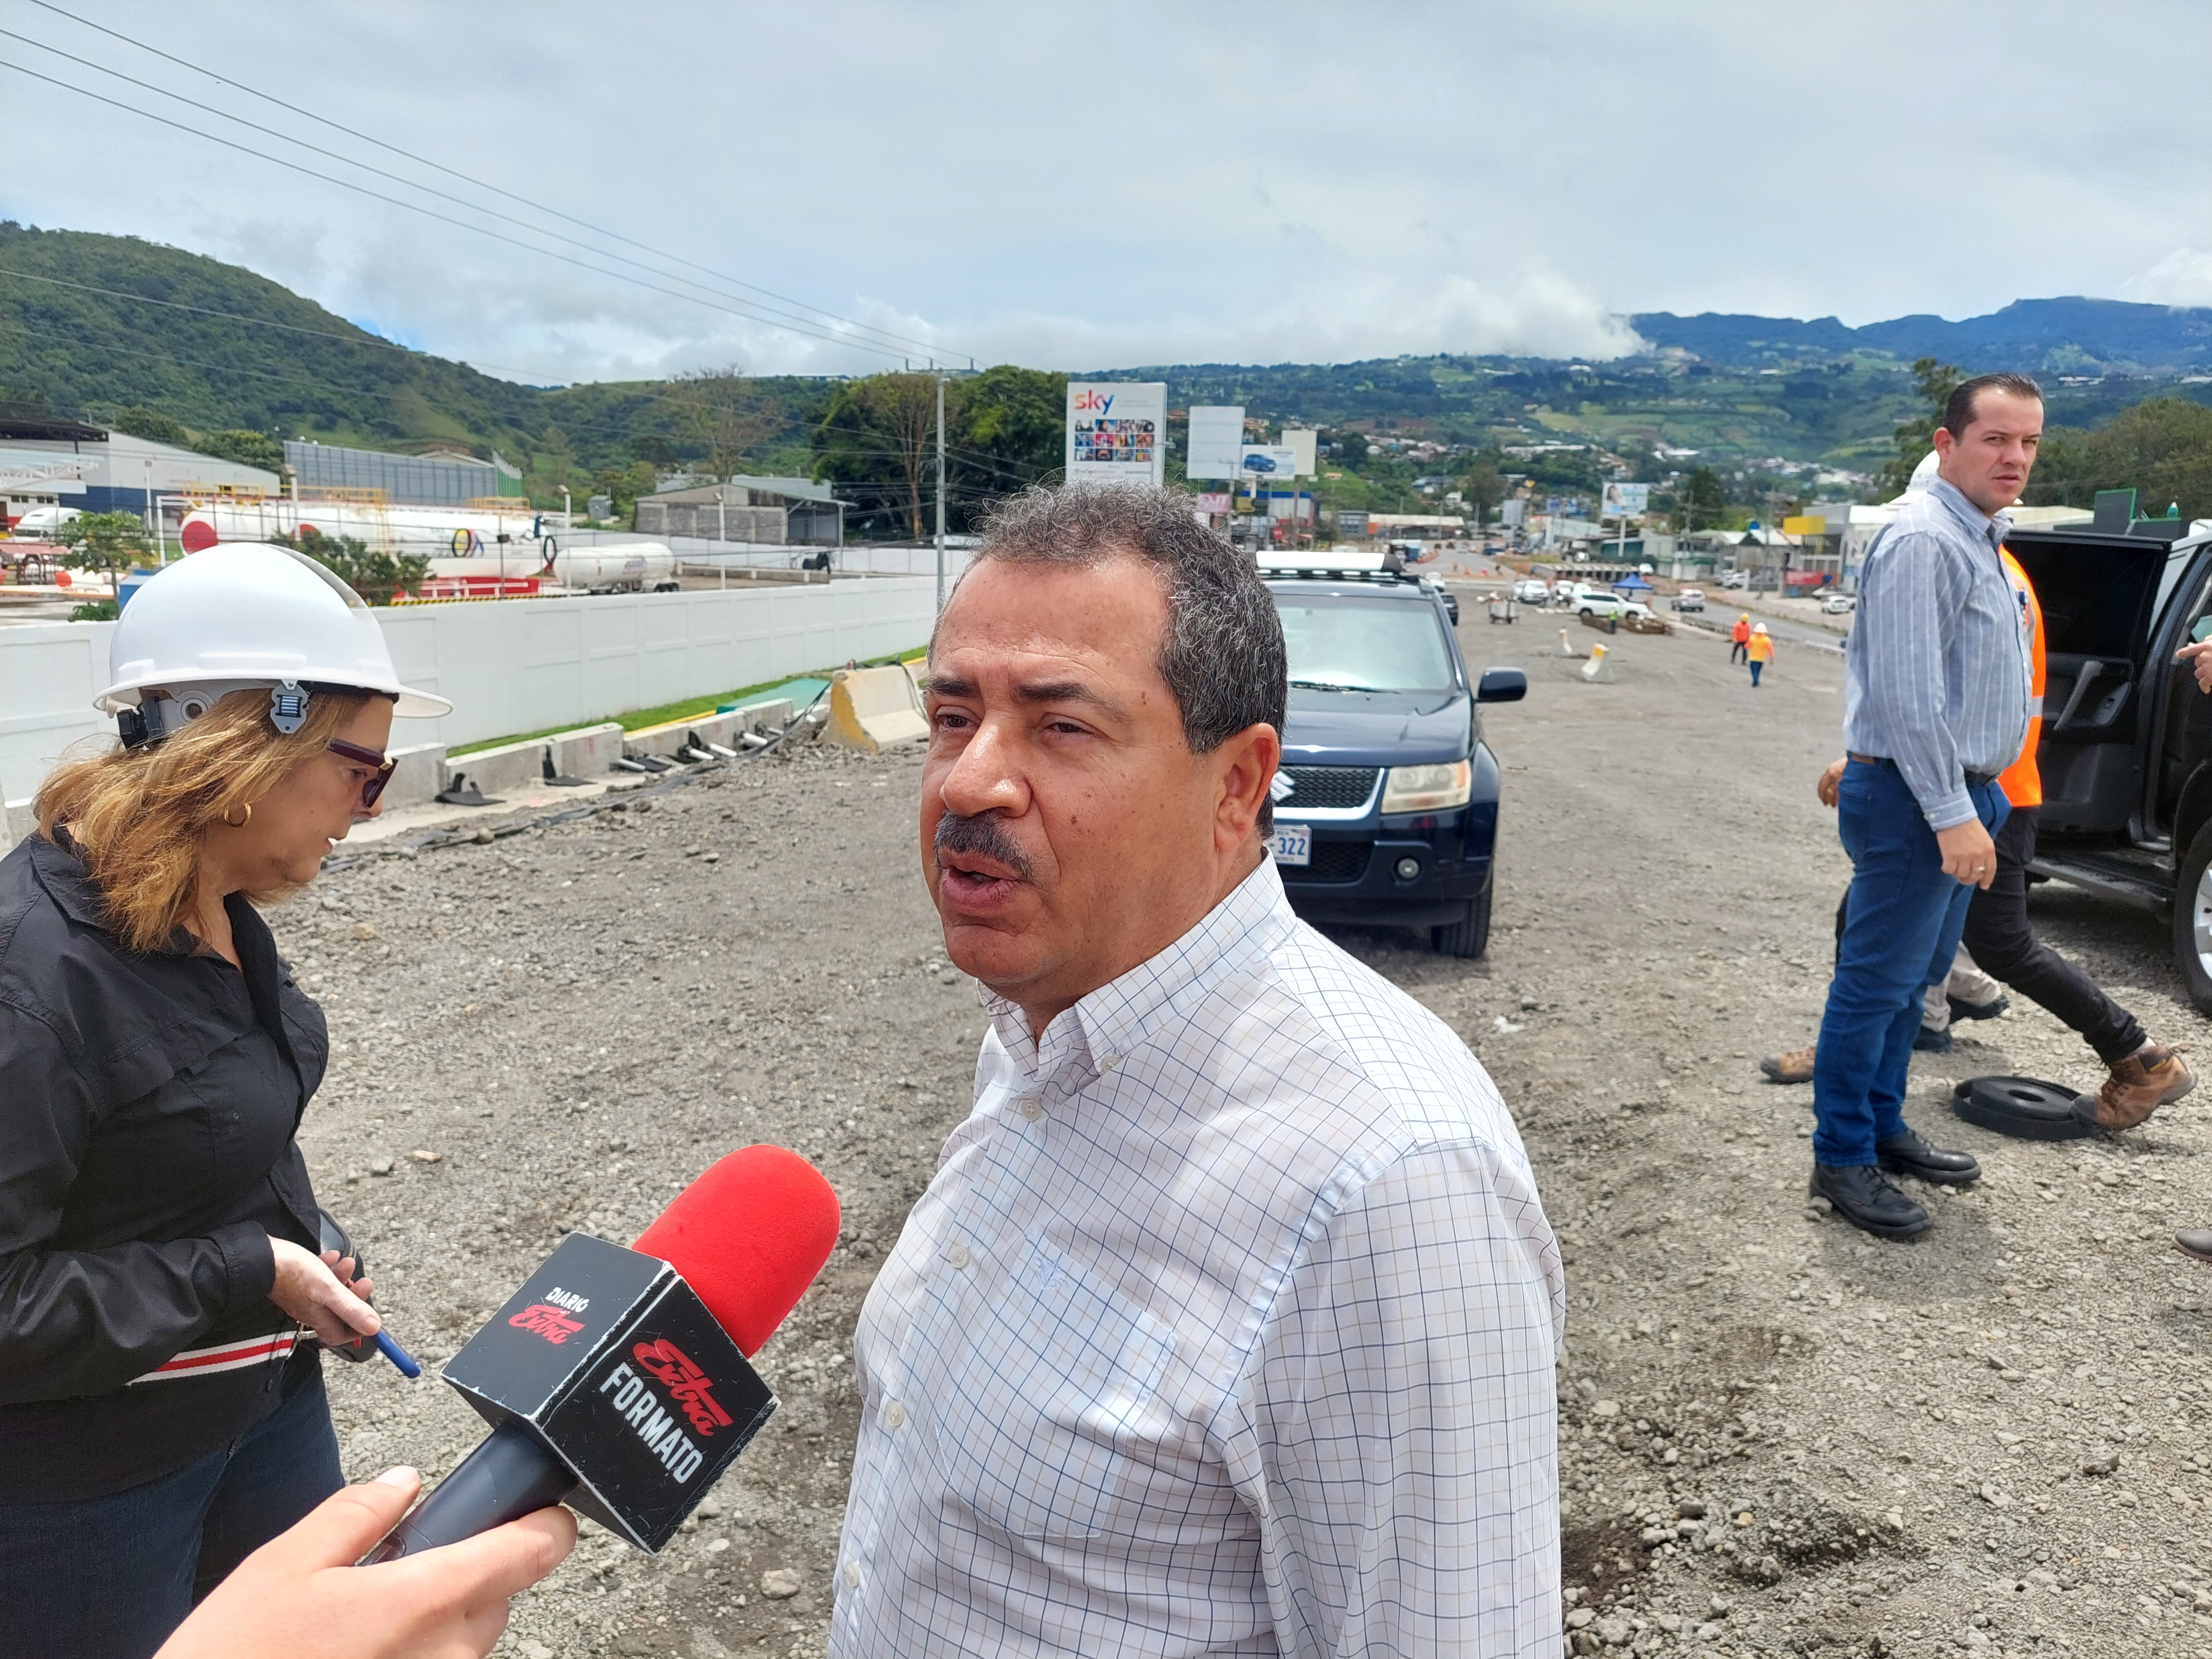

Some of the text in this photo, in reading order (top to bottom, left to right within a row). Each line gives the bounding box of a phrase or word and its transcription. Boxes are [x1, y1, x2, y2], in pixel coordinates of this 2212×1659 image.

[1075, 389, 1115, 415] sky
[545, 1287, 589, 1313] DIARIO
[509, 1305, 586, 1344] Extra
[633, 1339, 734, 1436] Extra
[599, 1361, 703, 1483] FORMATO
